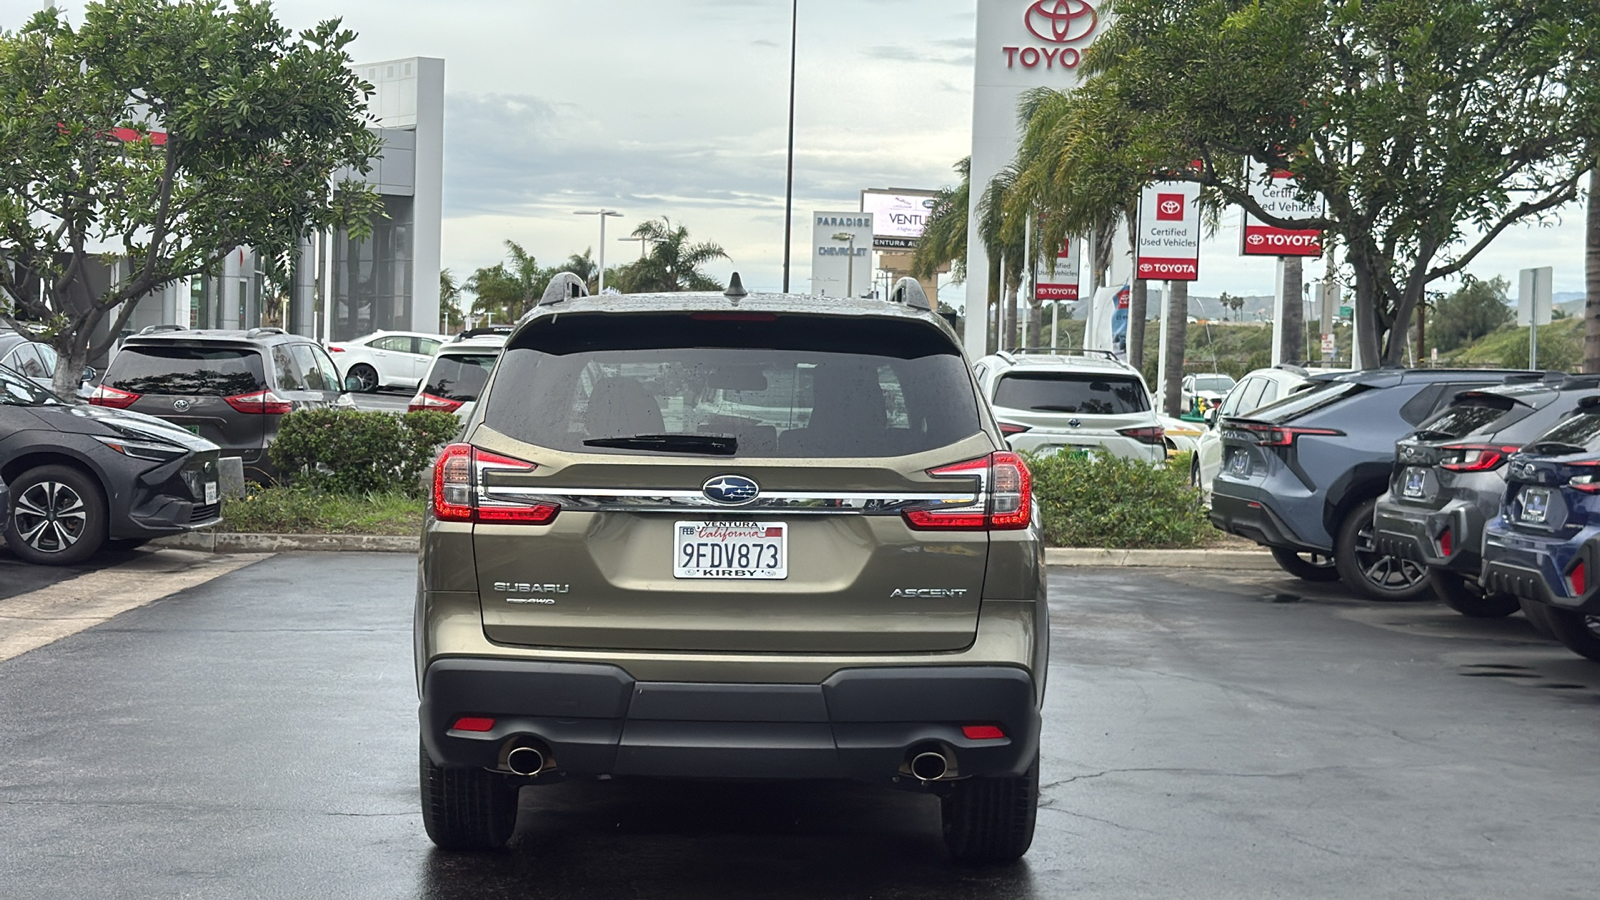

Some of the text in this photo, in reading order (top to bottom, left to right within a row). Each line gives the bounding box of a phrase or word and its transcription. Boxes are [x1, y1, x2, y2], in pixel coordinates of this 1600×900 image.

[1002, 46, 1091, 69] TOYO
[816, 217, 870, 227] PARADISE
[889, 213, 929, 225] VENTU
[1150, 227, 1187, 236] Certified
[1140, 238, 1197, 247] Used Vehicles
[1265, 234, 1320, 246] TOYOTA
[1153, 263, 1196, 273] TOYOTA
[698, 527, 763, 541] California
[682, 543, 778, 568] 9FDV873
[493, 582, 569, 593] SUBARU
[890, 588, 967, 598] ASCENT
